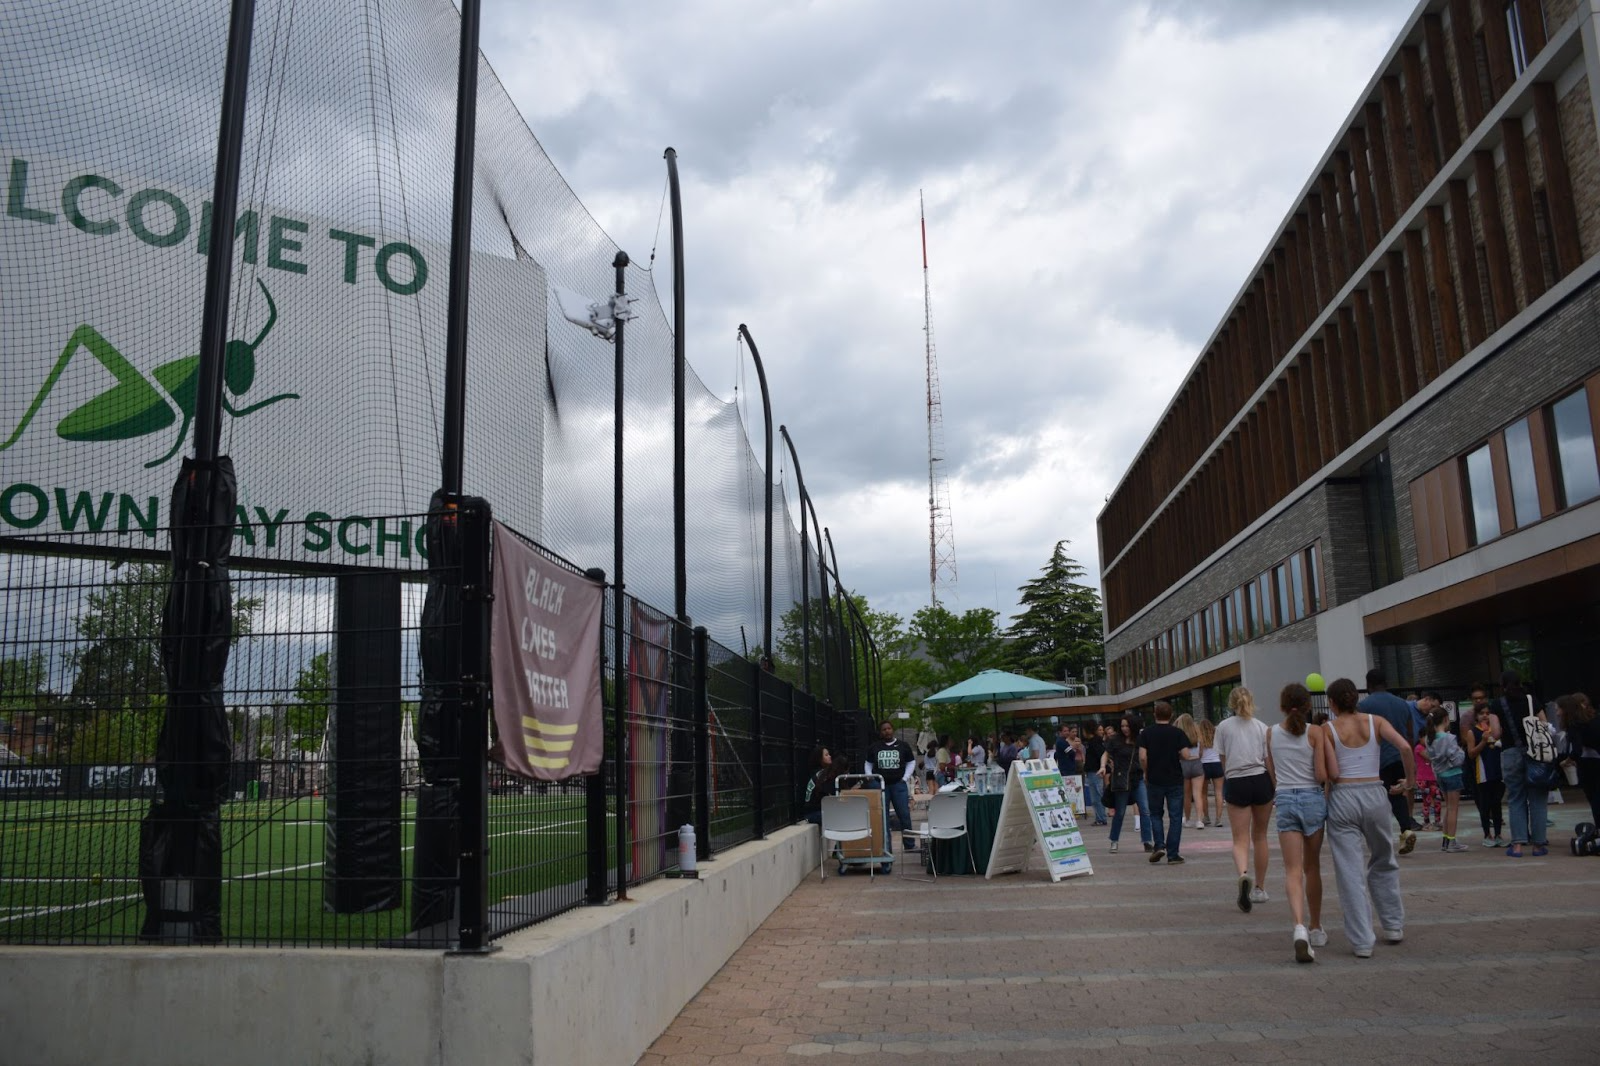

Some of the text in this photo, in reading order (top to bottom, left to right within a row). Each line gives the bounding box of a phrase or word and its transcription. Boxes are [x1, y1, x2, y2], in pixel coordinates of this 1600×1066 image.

[329, 229, 428, 295] TO
[0, 483, 429, 560] OWN AY SCH
[524, 567, 565, 616] BLACK
[877, 750, 900, 760] GDS
